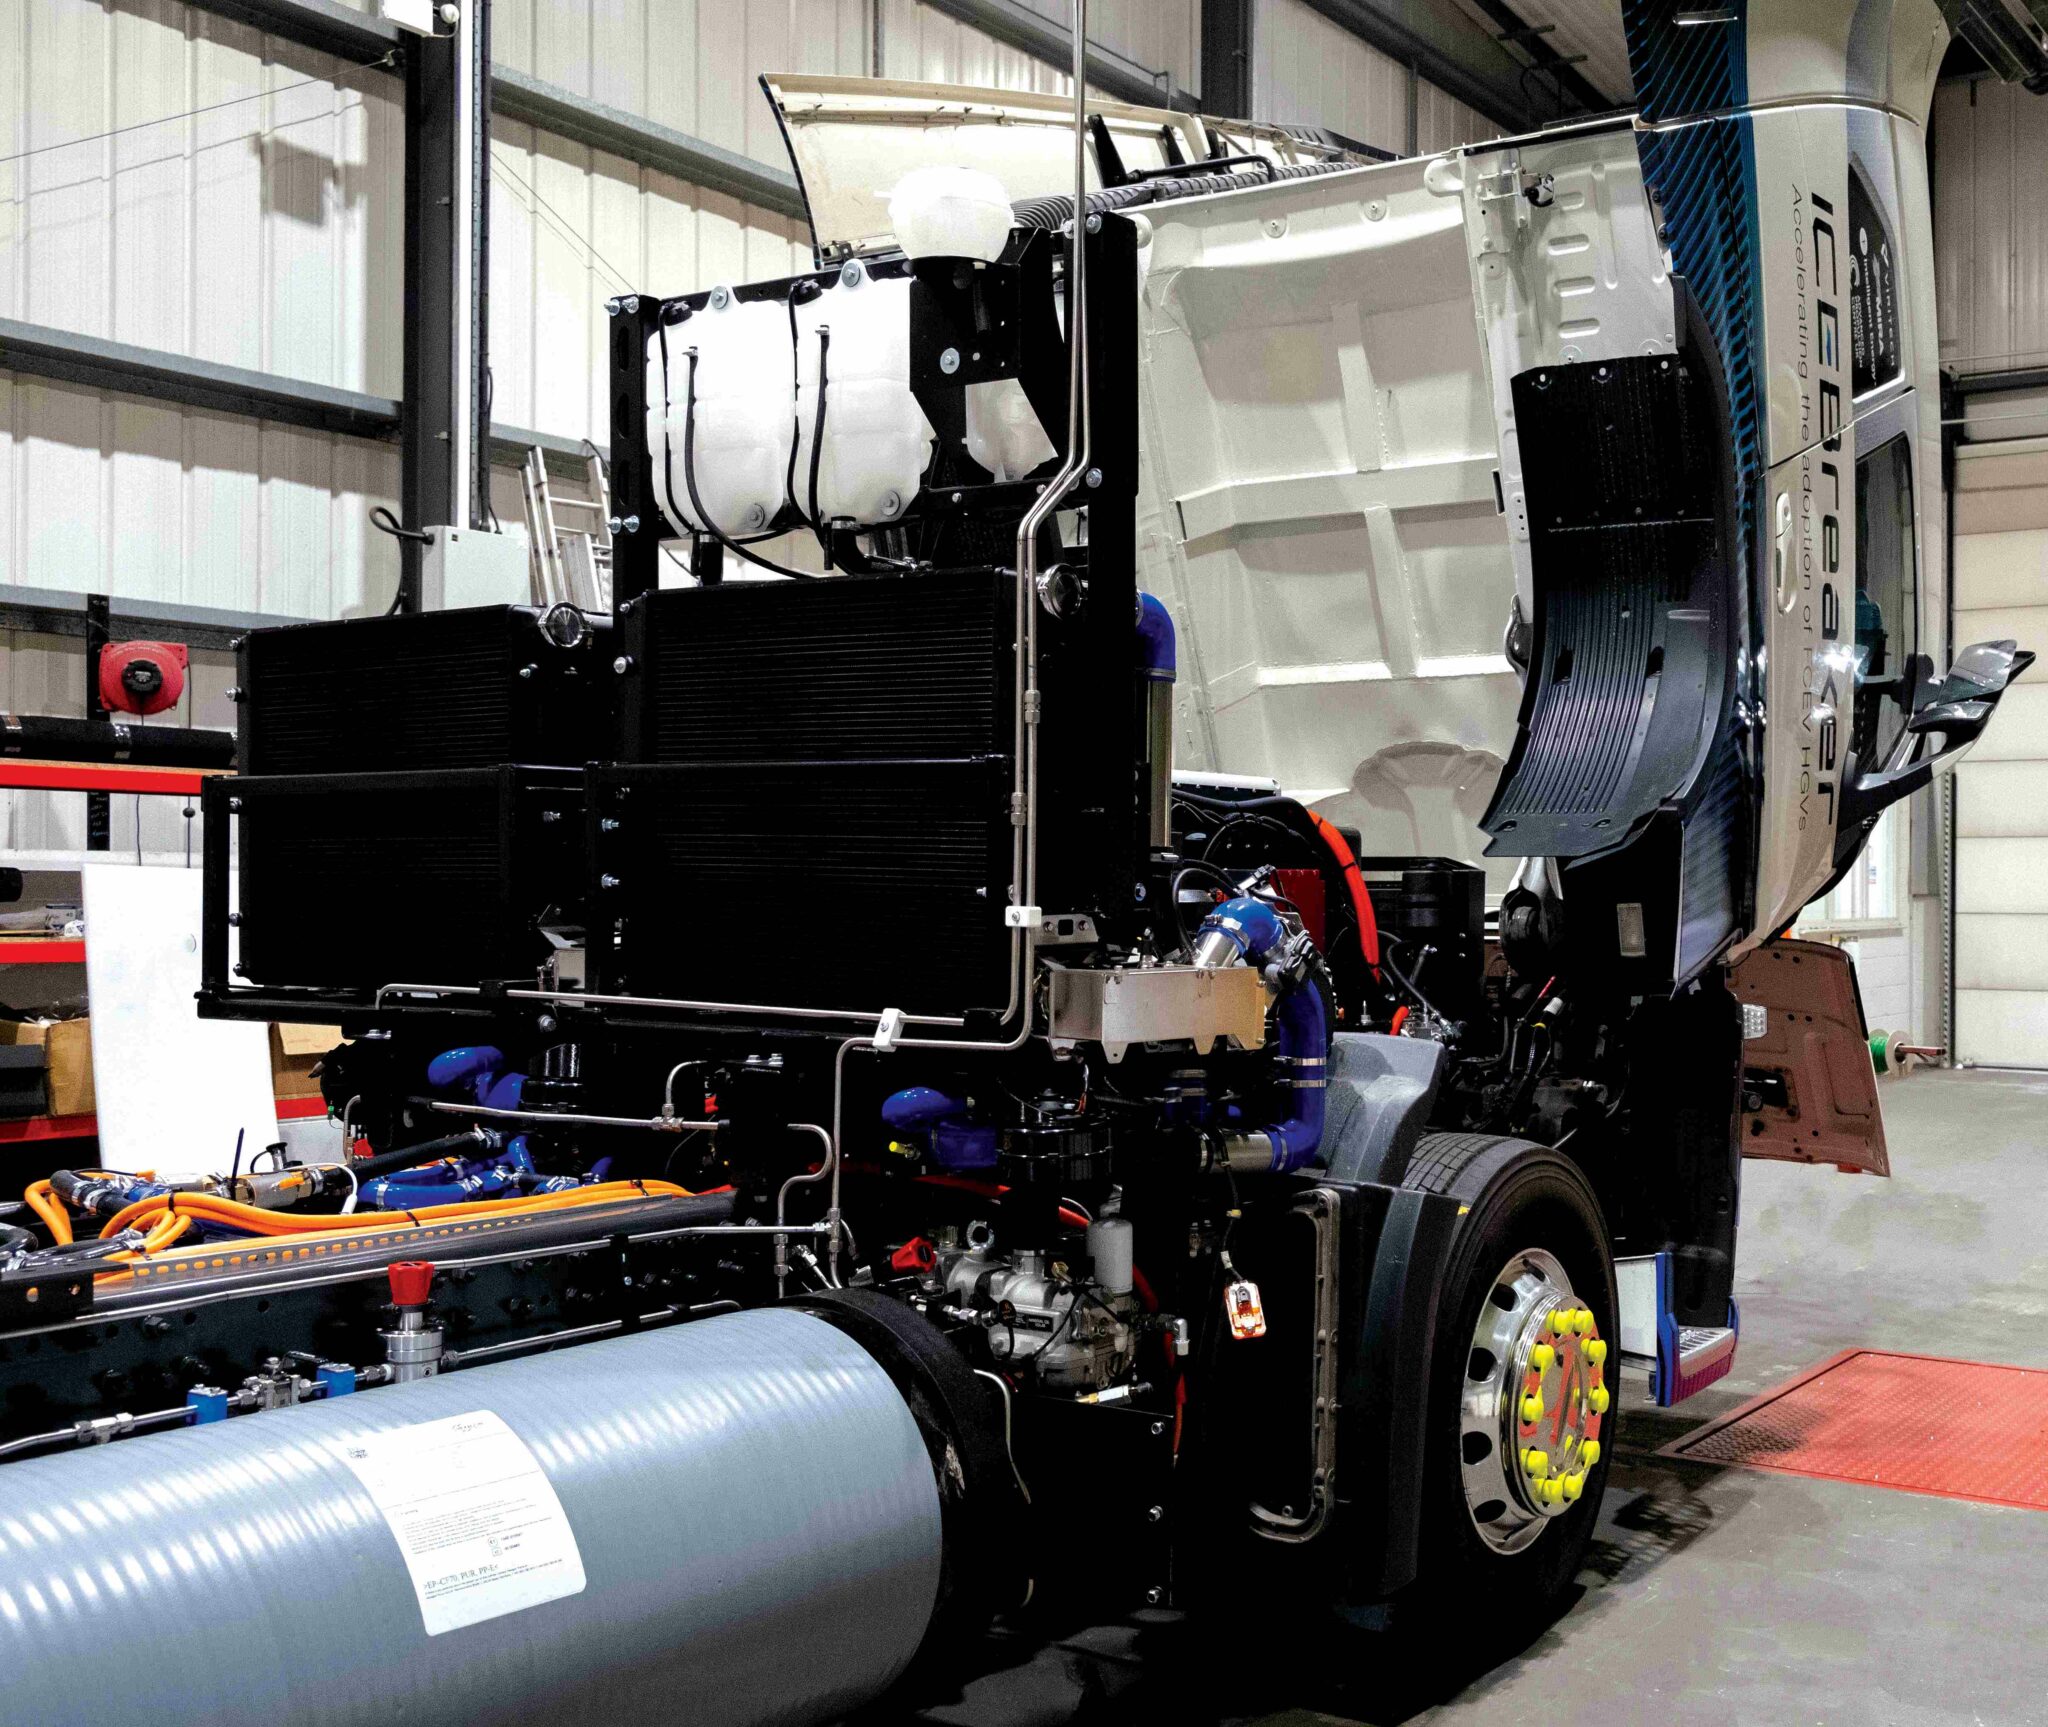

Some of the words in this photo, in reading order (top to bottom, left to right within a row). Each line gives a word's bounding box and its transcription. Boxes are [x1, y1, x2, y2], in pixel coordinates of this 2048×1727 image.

[1791, 183, 1809, 378] Accelerating
[1864, 258, 1873, 328] Intelligent
[1875, 296, 1884, 356] MIRA
[1801, 393, 1811, 441] the
[1800, 455, 1813, 590] adoption
[1802, 605, 1813, 633] of
[1801, 647, 1813, 733] FCEV
[1798, 746, 1811, 831] HGVs
